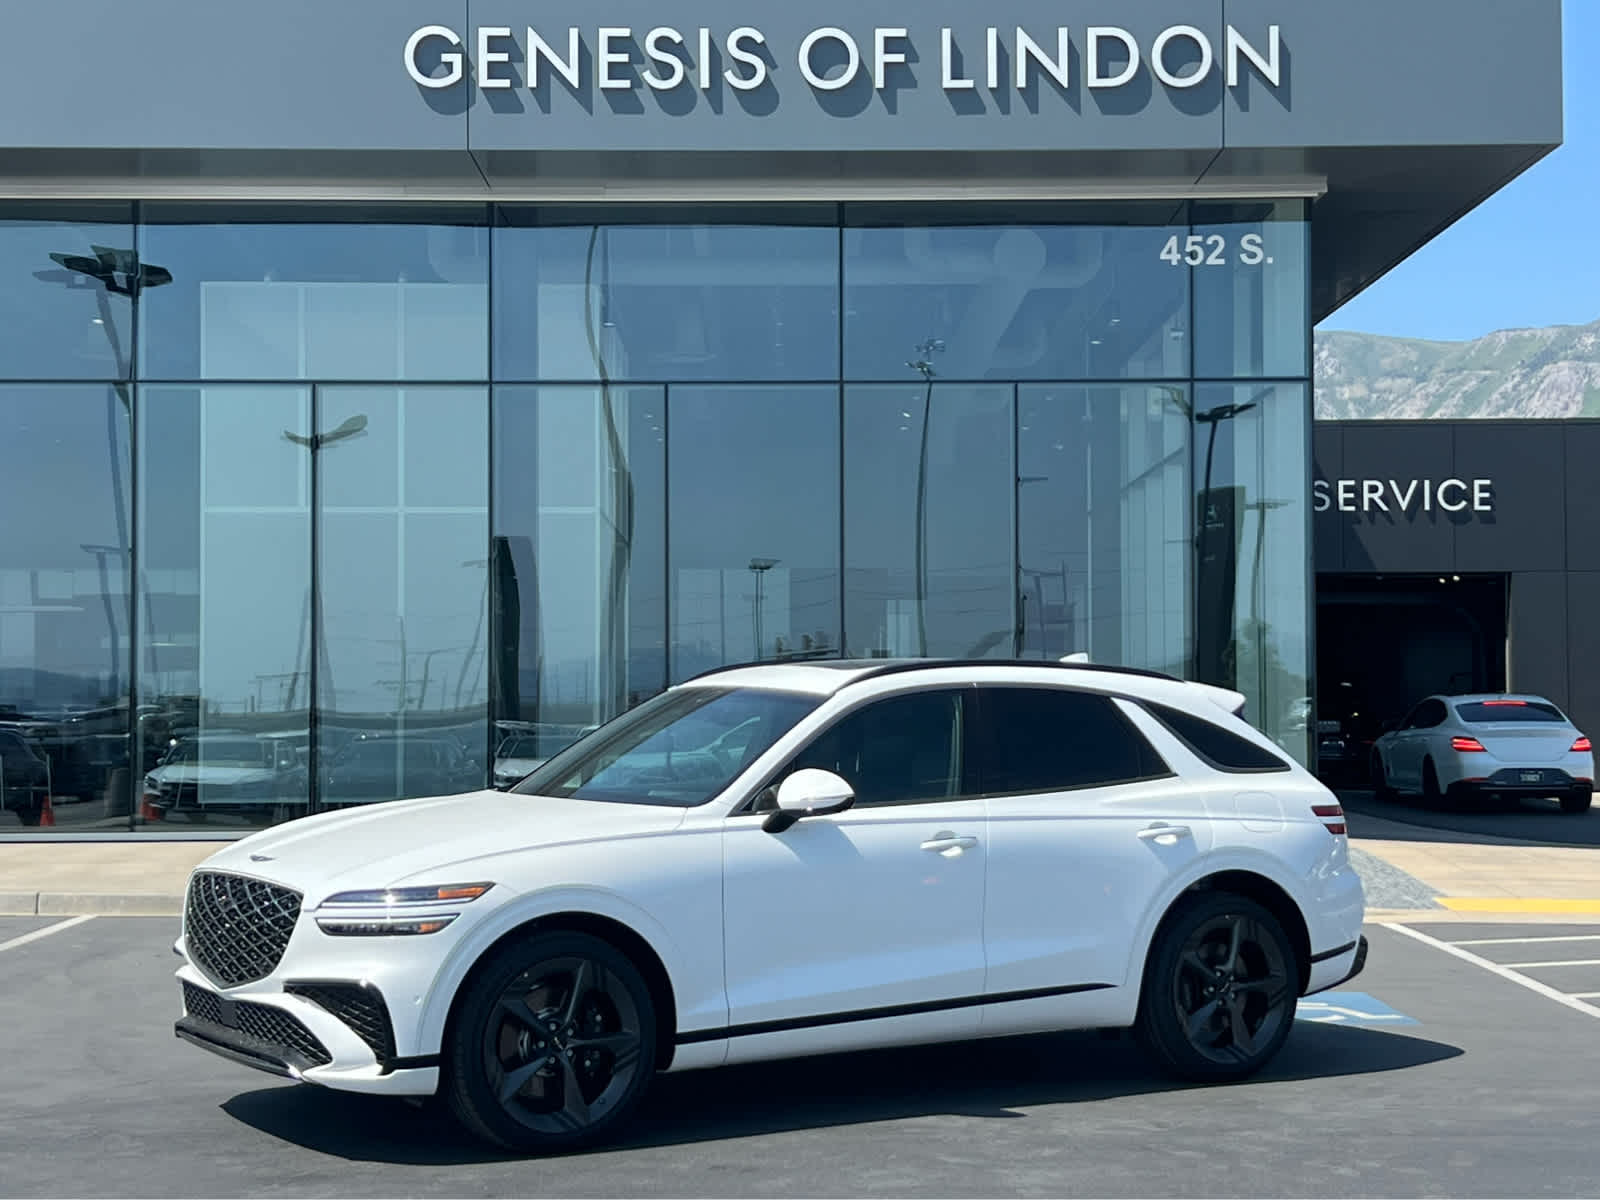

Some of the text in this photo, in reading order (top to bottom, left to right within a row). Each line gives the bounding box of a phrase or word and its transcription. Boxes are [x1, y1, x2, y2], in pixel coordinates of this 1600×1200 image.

[404, 24, 1279, 91] GENESIS OF LINDON
[1159, 233, 1274, 266] 452 S.
[1313, 478, 1492, 512] SERVICE
